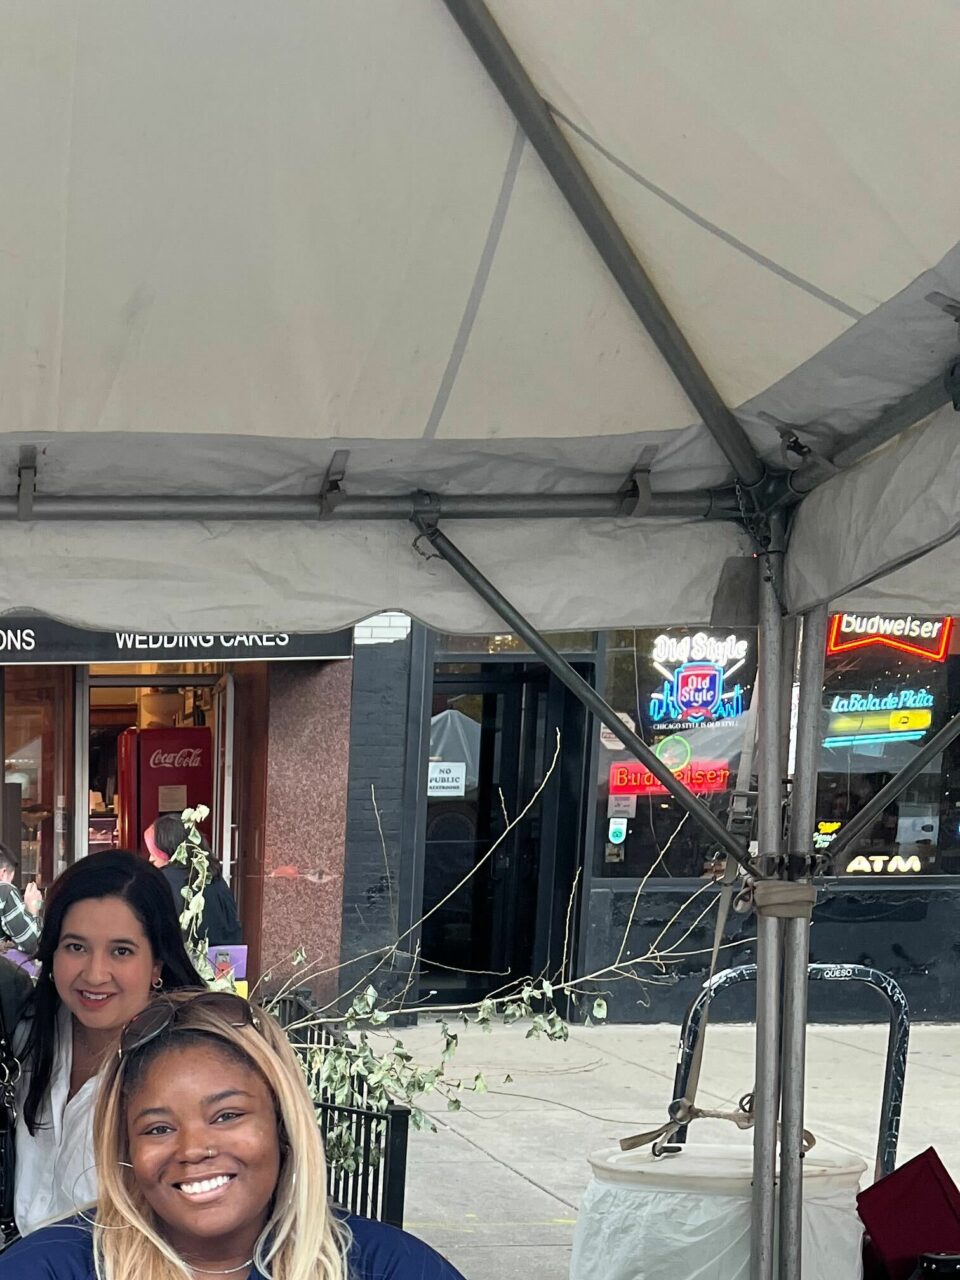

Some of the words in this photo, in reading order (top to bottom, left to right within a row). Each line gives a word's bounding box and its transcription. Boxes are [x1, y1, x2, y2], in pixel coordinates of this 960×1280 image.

[841, 614, 942, 638] Budweiser
[652, 634, 690, 662] Old
[690, 632, 748, 666] Style
[688, 676, 709, 688] Old
[680, 687, 714, 706] Style
[831, 696, 848, 712] La
[848, 694, 880, 711] Bala
[880, 693, 898, 709] de
[846, 855, 921, 873] ATM
[823, 968, 853, 978] QUESO
